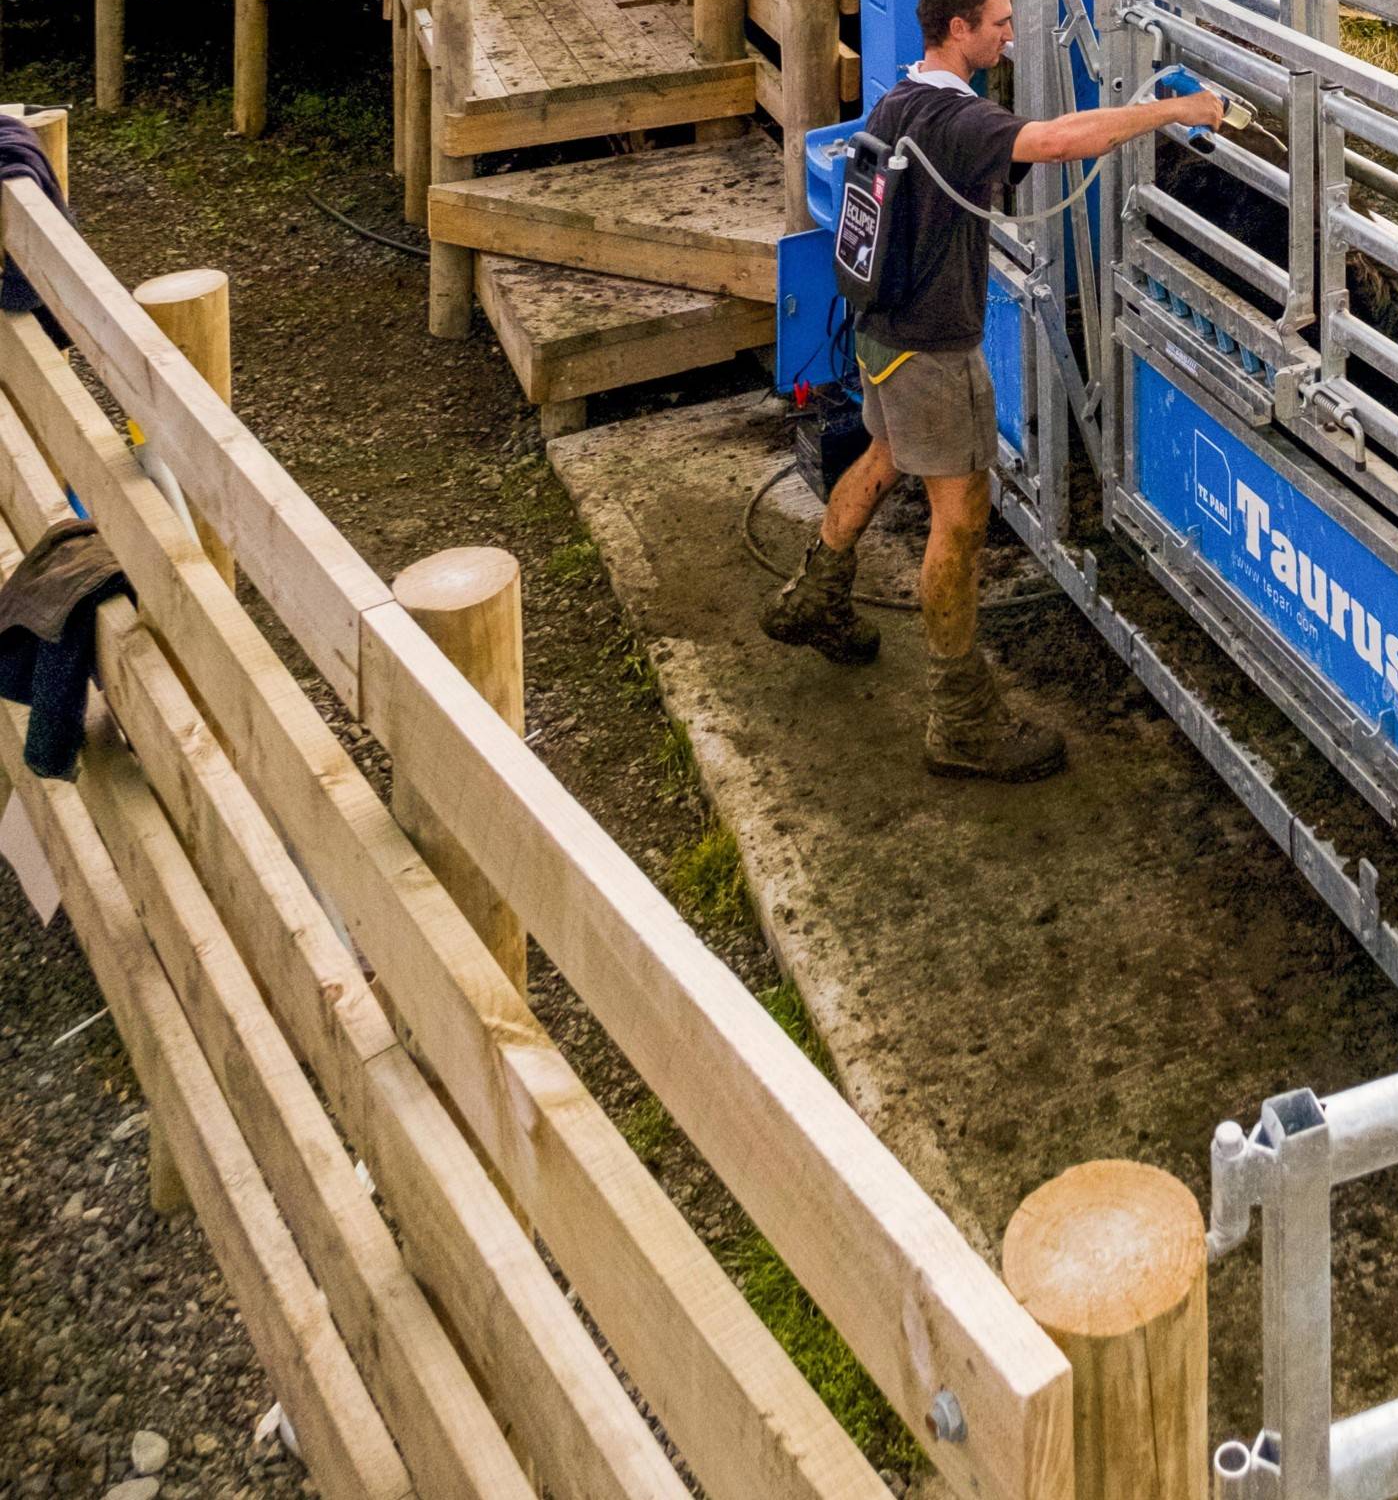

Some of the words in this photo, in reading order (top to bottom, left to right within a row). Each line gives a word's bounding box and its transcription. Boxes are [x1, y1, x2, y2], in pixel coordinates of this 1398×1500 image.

[847, 200, 876, 236] ECLIPSE
[1198, 482, 1208, 503] TE
[1210, 493, 1228, 521] PARI
